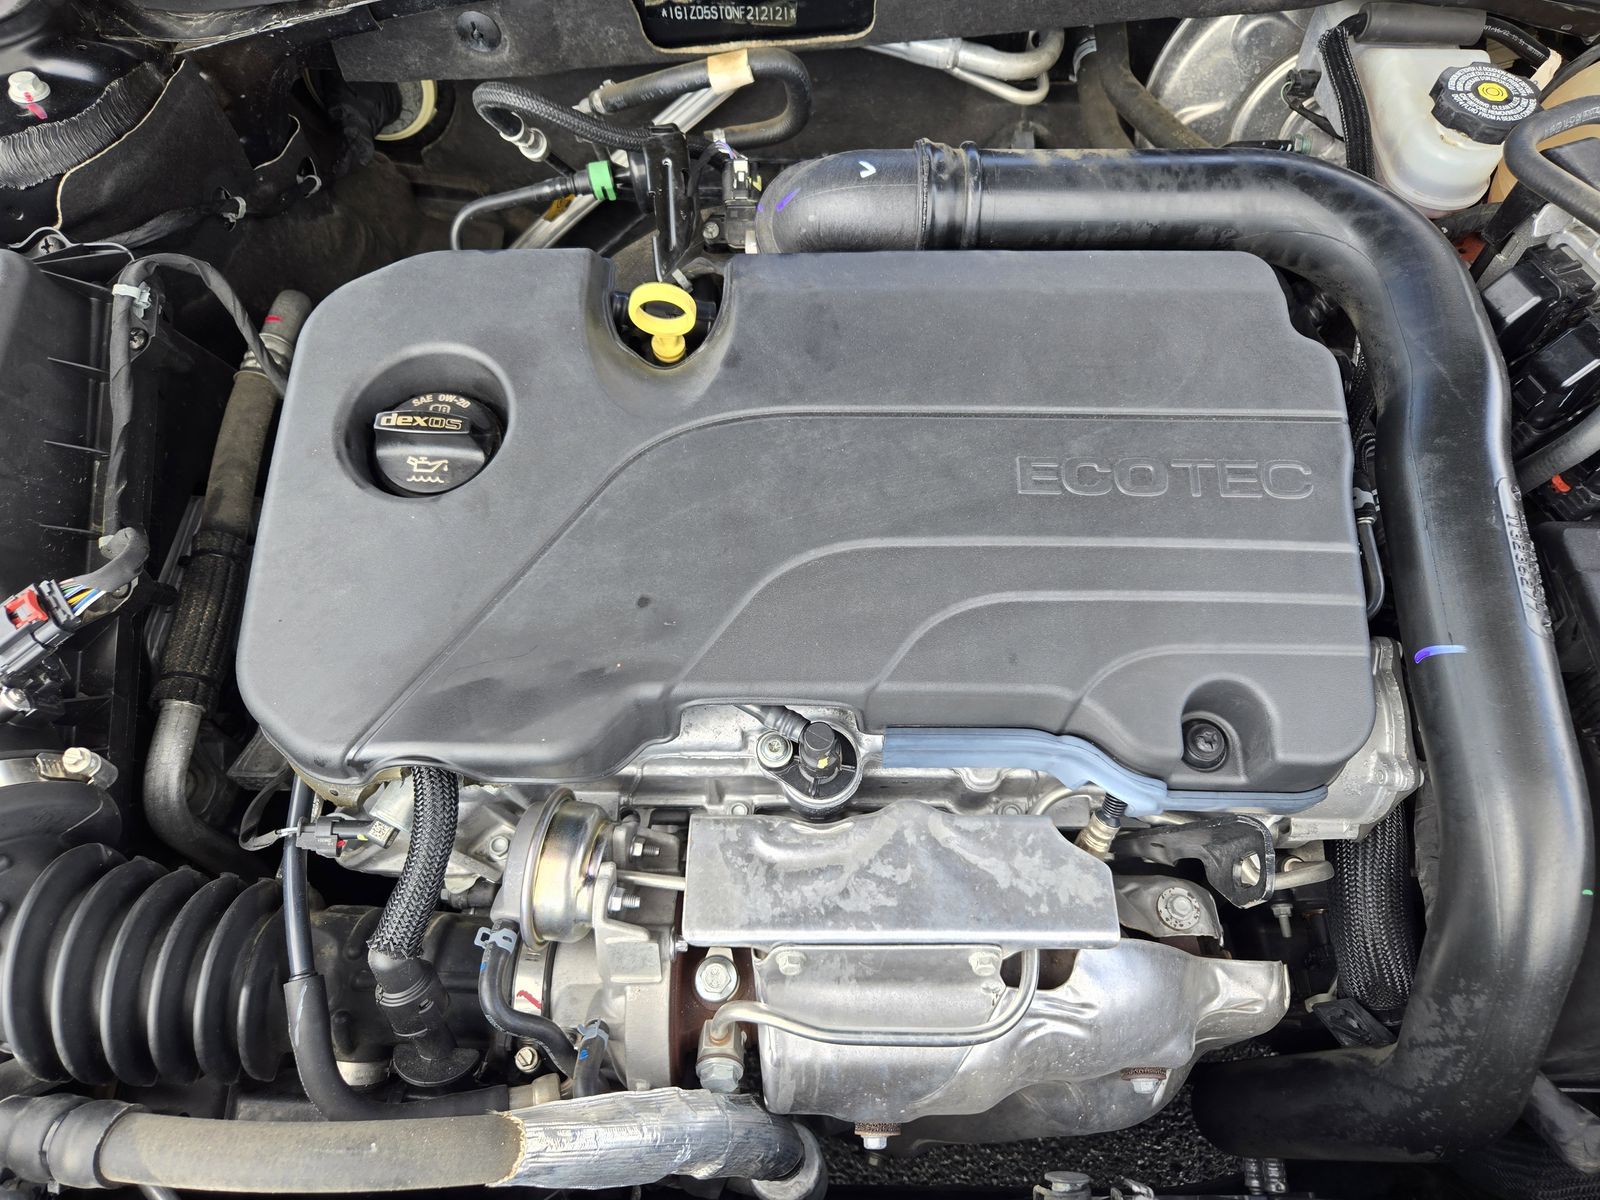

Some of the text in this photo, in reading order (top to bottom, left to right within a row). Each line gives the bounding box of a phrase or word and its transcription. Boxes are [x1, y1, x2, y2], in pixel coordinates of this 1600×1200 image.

[412, 394, 471, 408] SAE 0W-20
[1015, 455, 1314, 499] ECOTEC
